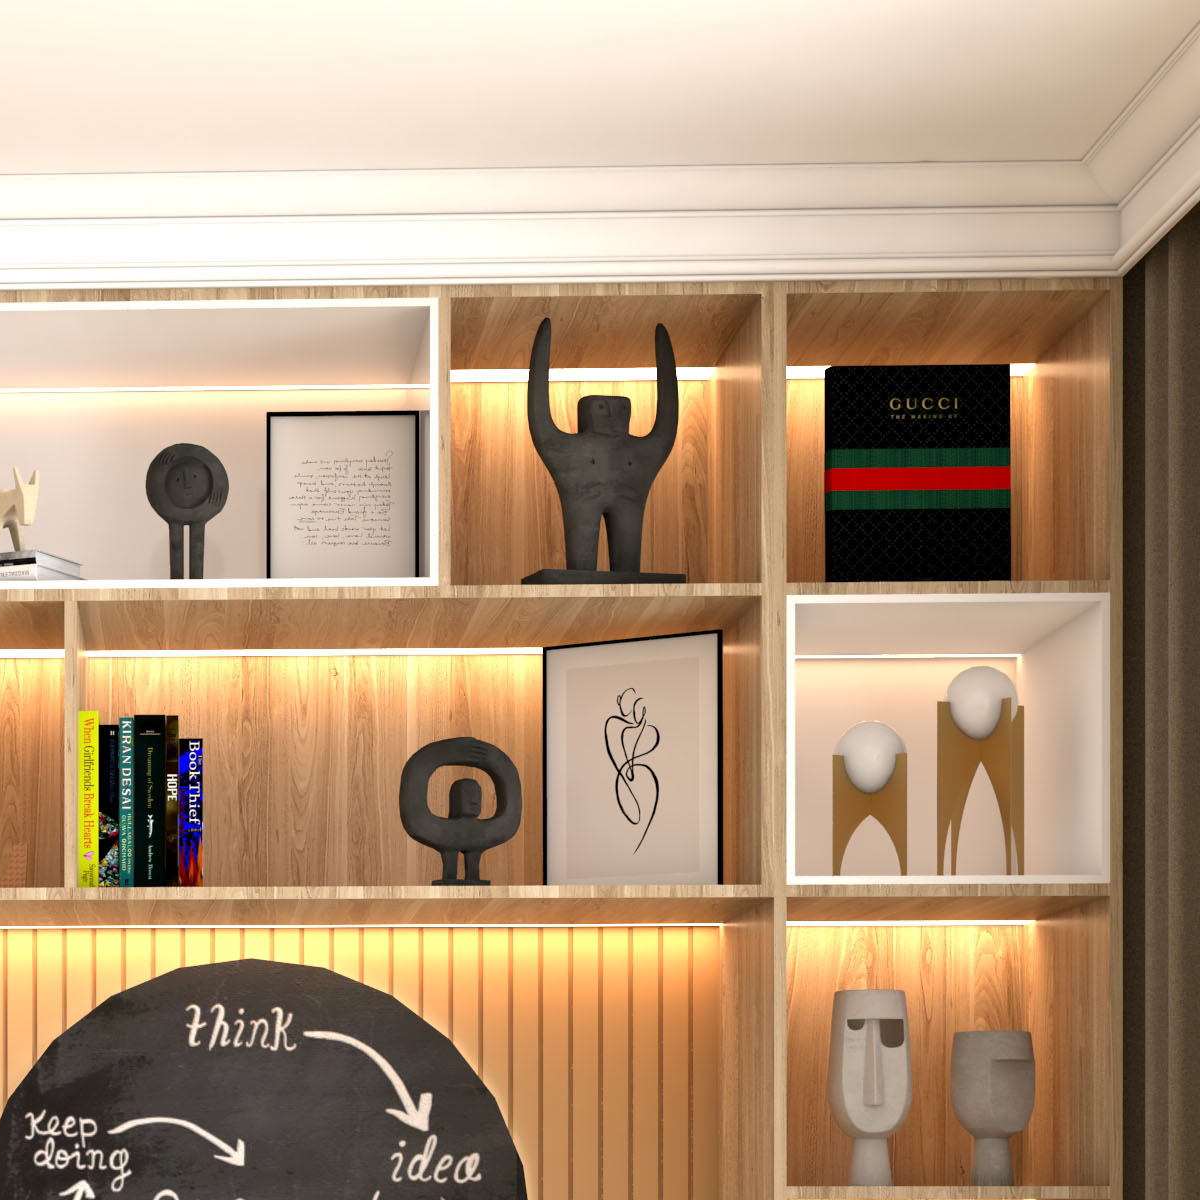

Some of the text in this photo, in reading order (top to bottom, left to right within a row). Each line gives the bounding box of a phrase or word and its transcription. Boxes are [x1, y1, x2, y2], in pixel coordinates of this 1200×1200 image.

[889, 397, 958, 411] GUCCI
[83, 717, 95, 849] When Girlfriends Break Hearts
[121, 720, 132, 810] KIRAN DESAI
[188, 741, 201, 781] Book
[166, 773, 178, 802] HOPE
[188, 781, 201, 826] Thief
[184, 1002, 298, 1052] think
[33, 1136, 132, 1192] doing
[390, 1134, 482, 1184] idea
